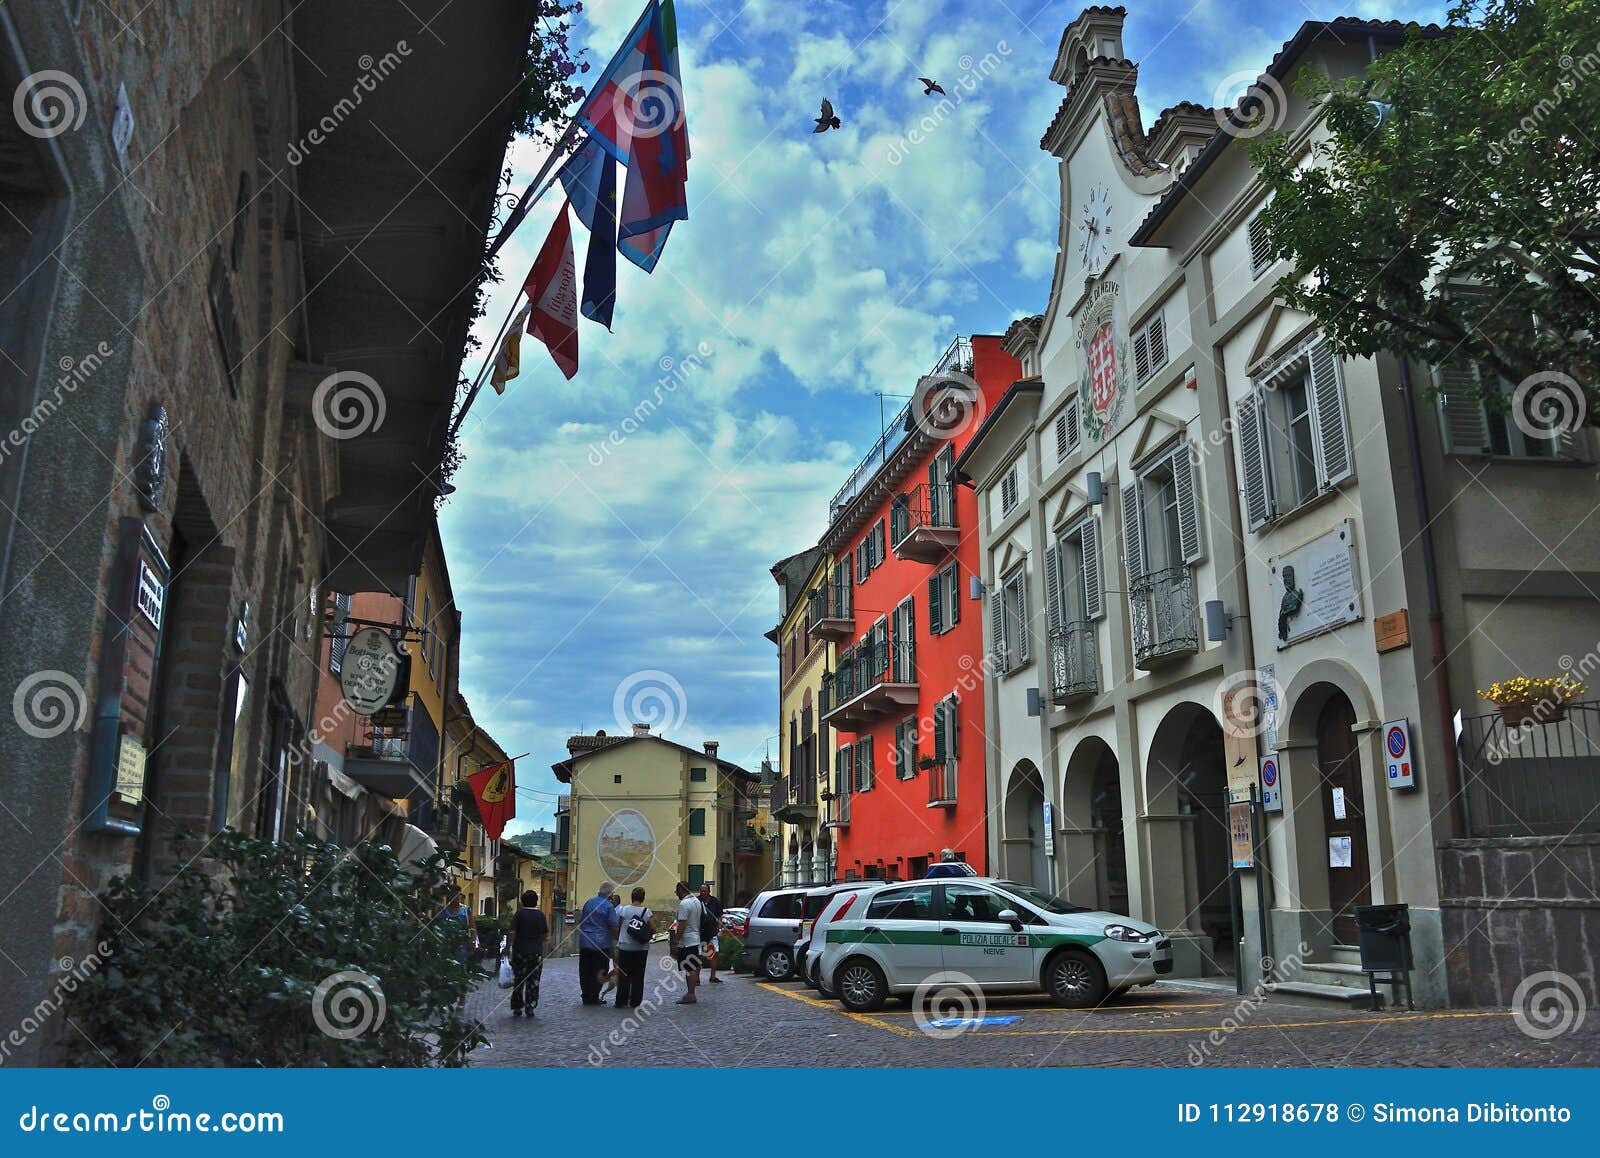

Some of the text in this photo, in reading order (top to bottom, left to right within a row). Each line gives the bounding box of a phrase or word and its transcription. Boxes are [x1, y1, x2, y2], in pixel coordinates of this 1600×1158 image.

[1075, 296, 1094, 349] COMUNE
[1100, 281, 1120, 296] NEIVE
[1390, 766, 1397, 777] P
[962, 935, 1016, 945] POLIZIA LOCALE
[983, 948, 1006, 956] NEIVE
